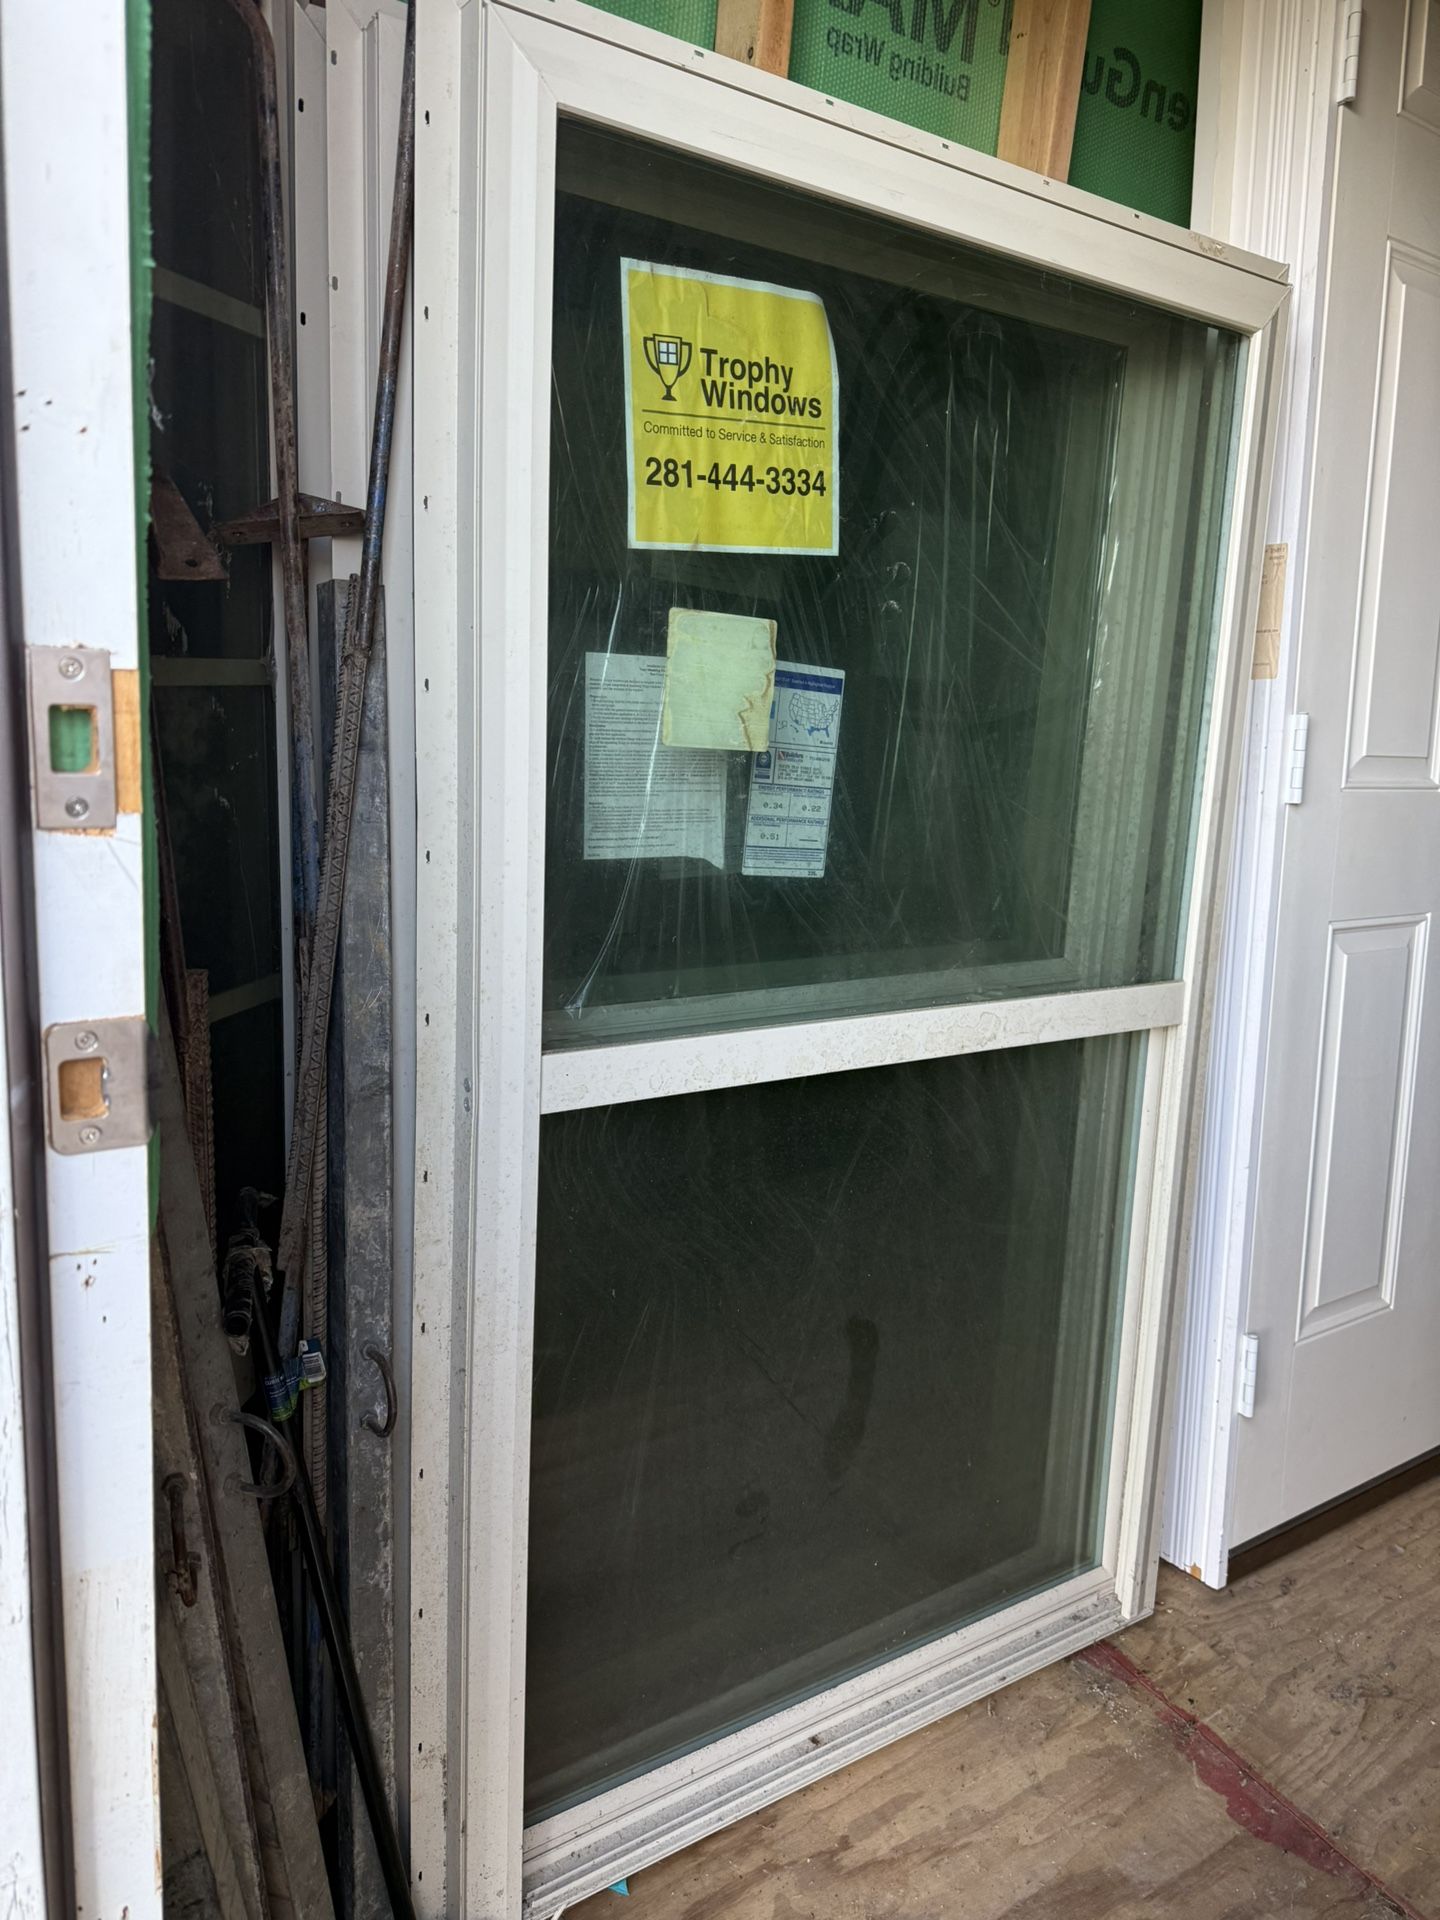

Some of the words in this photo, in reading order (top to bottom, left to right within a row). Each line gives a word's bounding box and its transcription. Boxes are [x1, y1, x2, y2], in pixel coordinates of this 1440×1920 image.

[700, 347, 794, 393] Trophy
[700, 378, 823, 419] Windows
[643, 420, 703, 438] Committed
[706, 427, 716, 439] to
[718, 429, 757, 443] Service
[759, 433, 767, 444] &
[769, 434, 826, 449] Satisfaction
[645, 456, 827, 497] 281-444-3334
[763, 802, 783, 810] 0.34
[801, 804, 821, 812] 0.22
